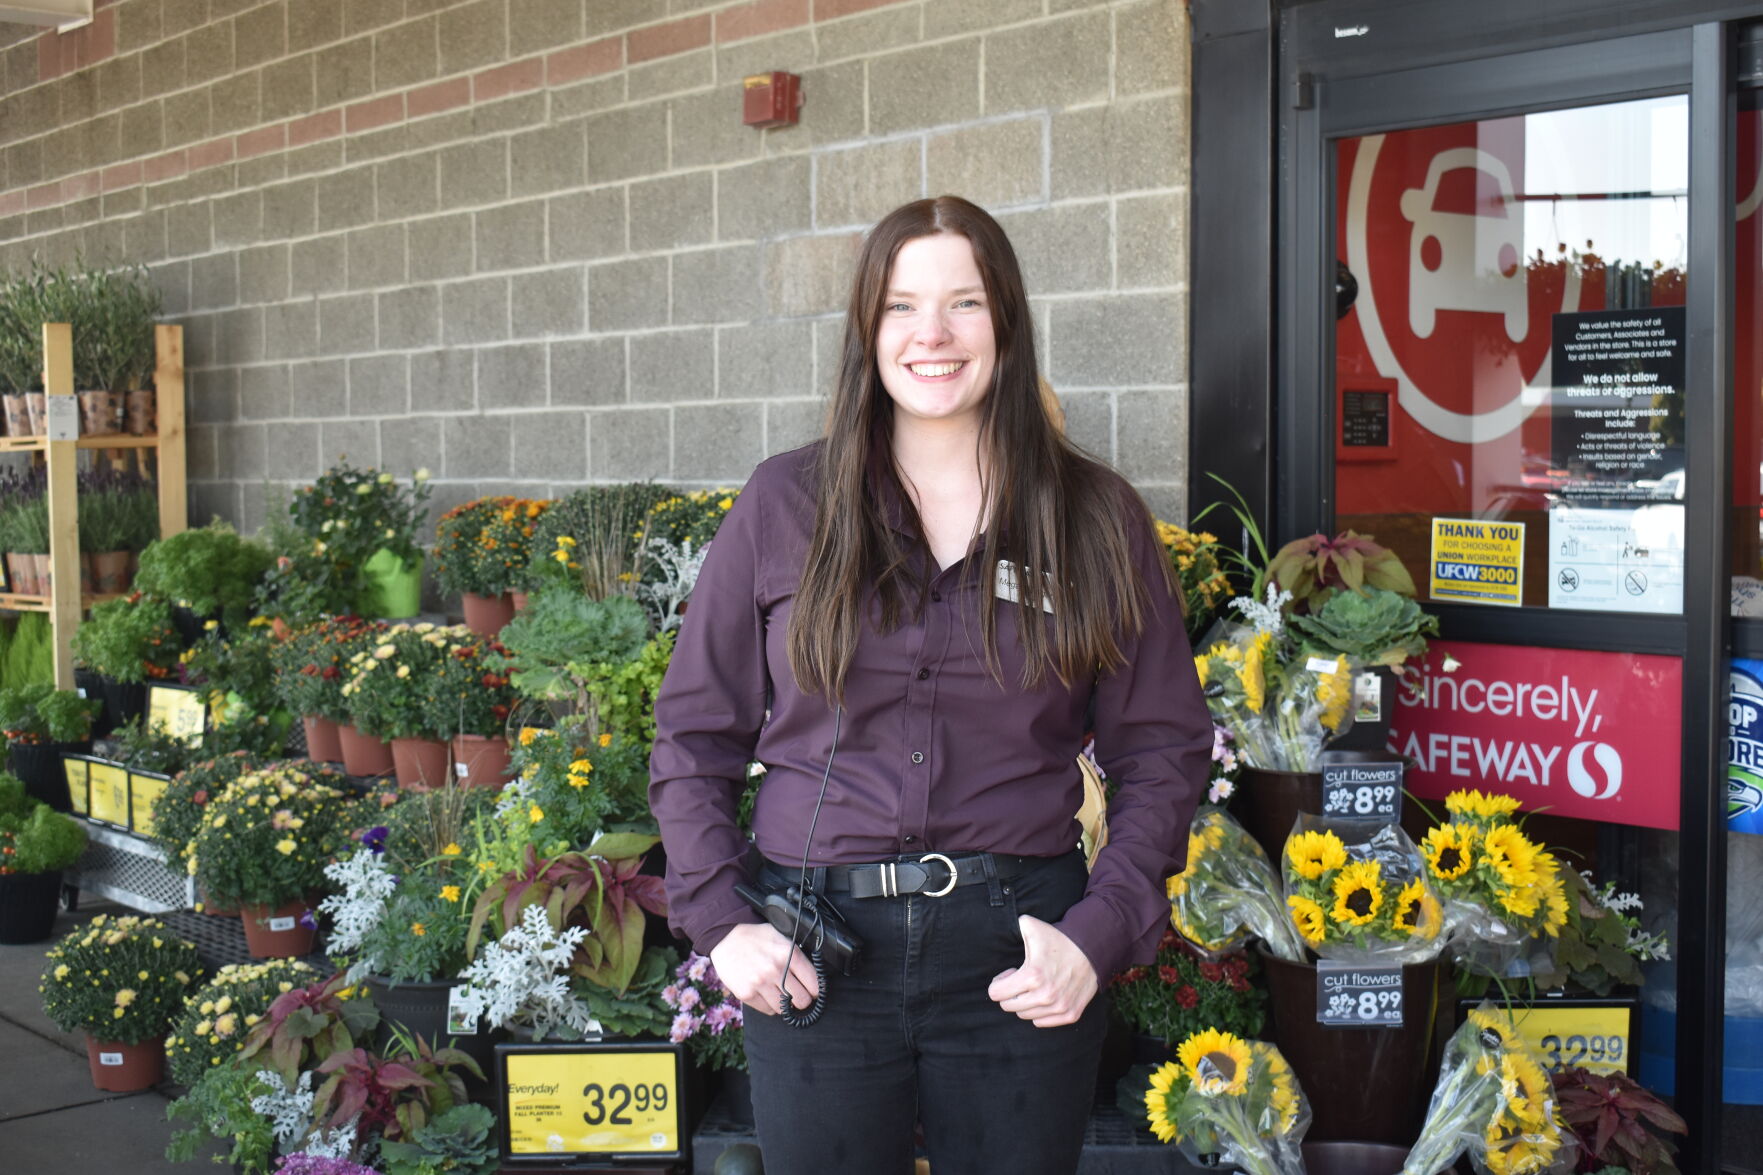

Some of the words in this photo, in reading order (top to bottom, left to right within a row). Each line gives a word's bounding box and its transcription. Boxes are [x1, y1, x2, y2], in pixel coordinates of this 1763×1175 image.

[1579, 322, 1590, 330] We
[1591, 321, 1609, 329] value
[1610, 320, 1622, 328] the
[1623, 319, 1643, 329] safety
[1644, 318, 1652, 326] of
[1653, 318, 1662, 326] all
[1576, 332, 1612, 341] Customers,
[1614, 330, 1649, 339] Associates
[1564, 343, 1591, 351] Vendors
[1592, 342, 1599, 350] in
[1600, 341, 1611, 350] the
[1612, 341, 1630, 349] store.
[1632, 340, 1644, 348] This
[1568, 353, 1578, 361] for
[1578, 352, 1587, 360] all
[1588, 352, 1595, 360] to
[1596, 352, 1608, 360] feel
[1609, 351, 1640, 359] welcome
[1641, 350, 1655, 358] and
[1656, 350, 1672, 358] safe.
[1583, 374, 1598, 384] We
[1600, 373, 1612, 384] do
[1614, 372, 1630, 383] not
[1632, 372, 1658, 382] allow
[1566, 387, 1600, 397] threats
[1614, 384, 1675, 398] aggressions.
[1574, 410, 1602, 418] Threats
[1604, 409, 1620, 418] and
[1620, 408, 1668, 419] Aggressions
[1605, 419, 1636, 428] Include:
[1585, 432, 1627, 441] Disrespectful
[1628, 432, 1660, 442] language
[1604, 442, 1627, 450] threats
[1637, 442, 1665, 450] violence
[1596, 462, 1620, 470] religion
[1438, 524, 1484, 539] THANK
[1490, 526, 1518, 540] YOU
[1443, 540, 1458, 548] FOR
[1461, 541, 1503, 552] CHOOSING
[1506, 544, 1512, 552] A
[1438, 552, 1464, 560] UNION
[1466, 554, 1517, 564] WORKPLACE
[1438, 563, 1515, 583] UFCW3000
[1398, 664, 1602, 738] Sincerely,
[1326, 770, 1348, 785] cut
[1351, 768, 1396, 781] flowers
[1378, 804, 1393, 813] ea
[1324, 974, 1348, 989] cut
[1352, 973, 1401, 986] flowers
[1384, 1010, 1400, 1018] ea
[508, 1083, 560, 1096] Everyday!
